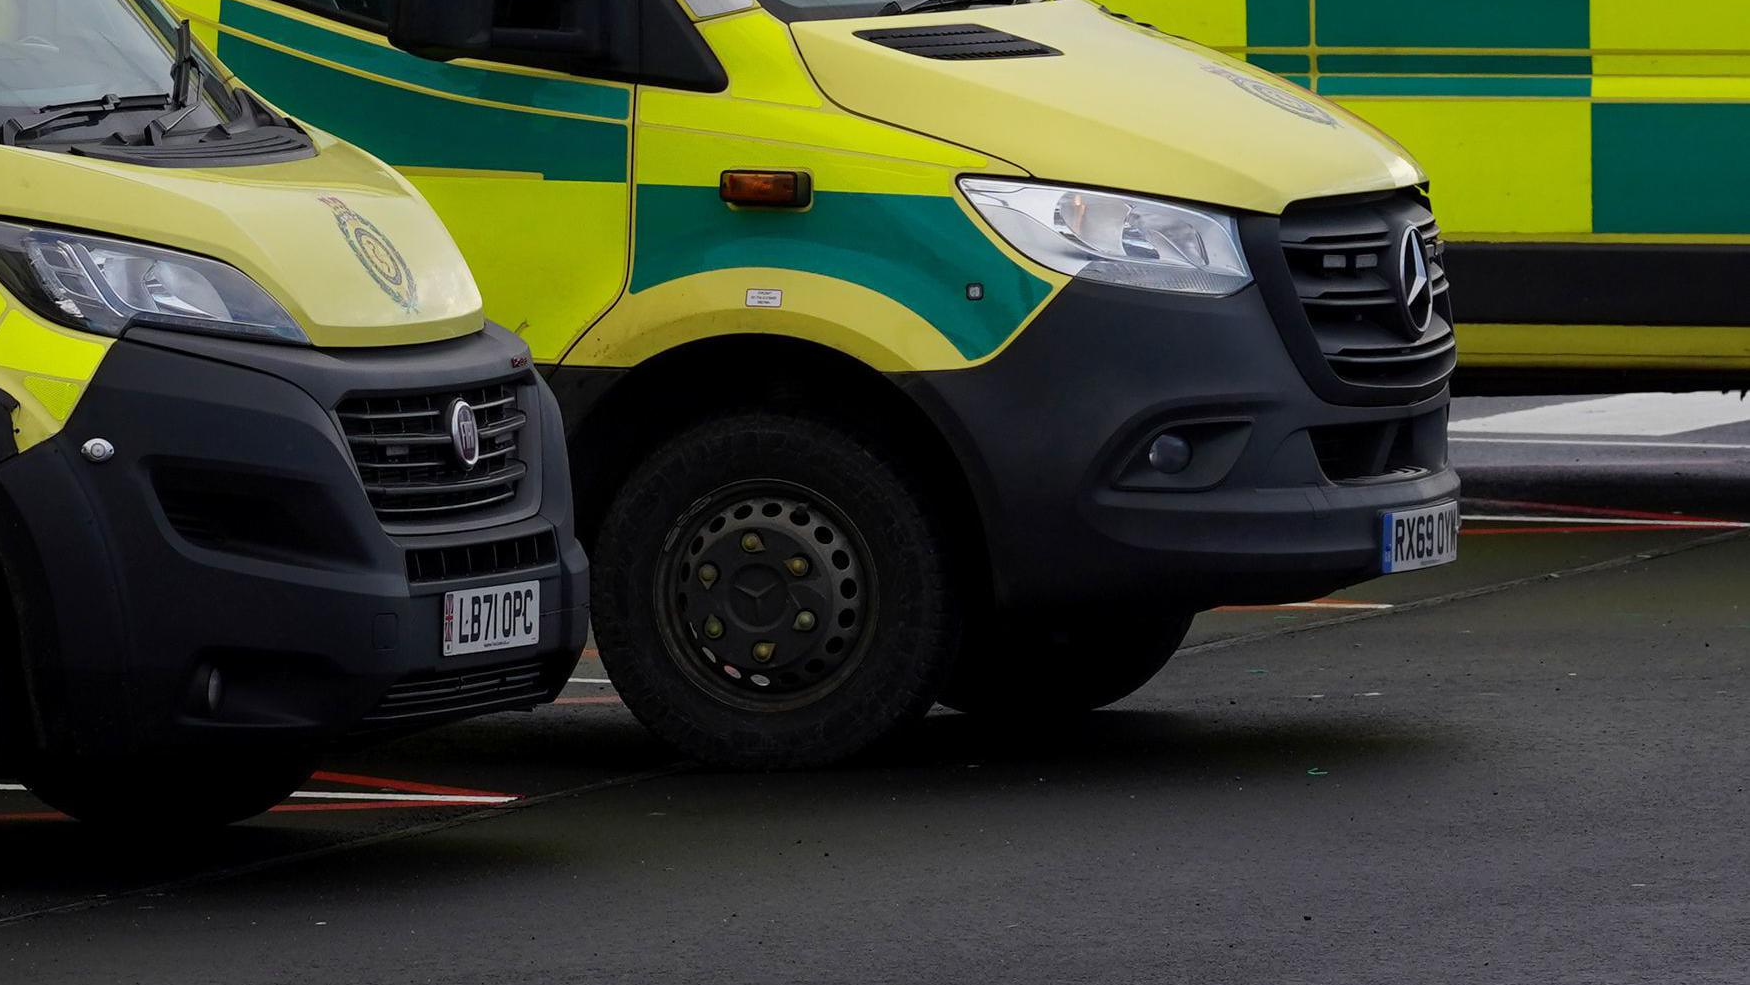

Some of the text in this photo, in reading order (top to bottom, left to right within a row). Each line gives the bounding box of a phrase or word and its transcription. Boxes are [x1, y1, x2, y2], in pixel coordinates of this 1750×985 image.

[1394, 515, 1435, 562] RX69
[458, 588, 534, 644] LB71 OPC
